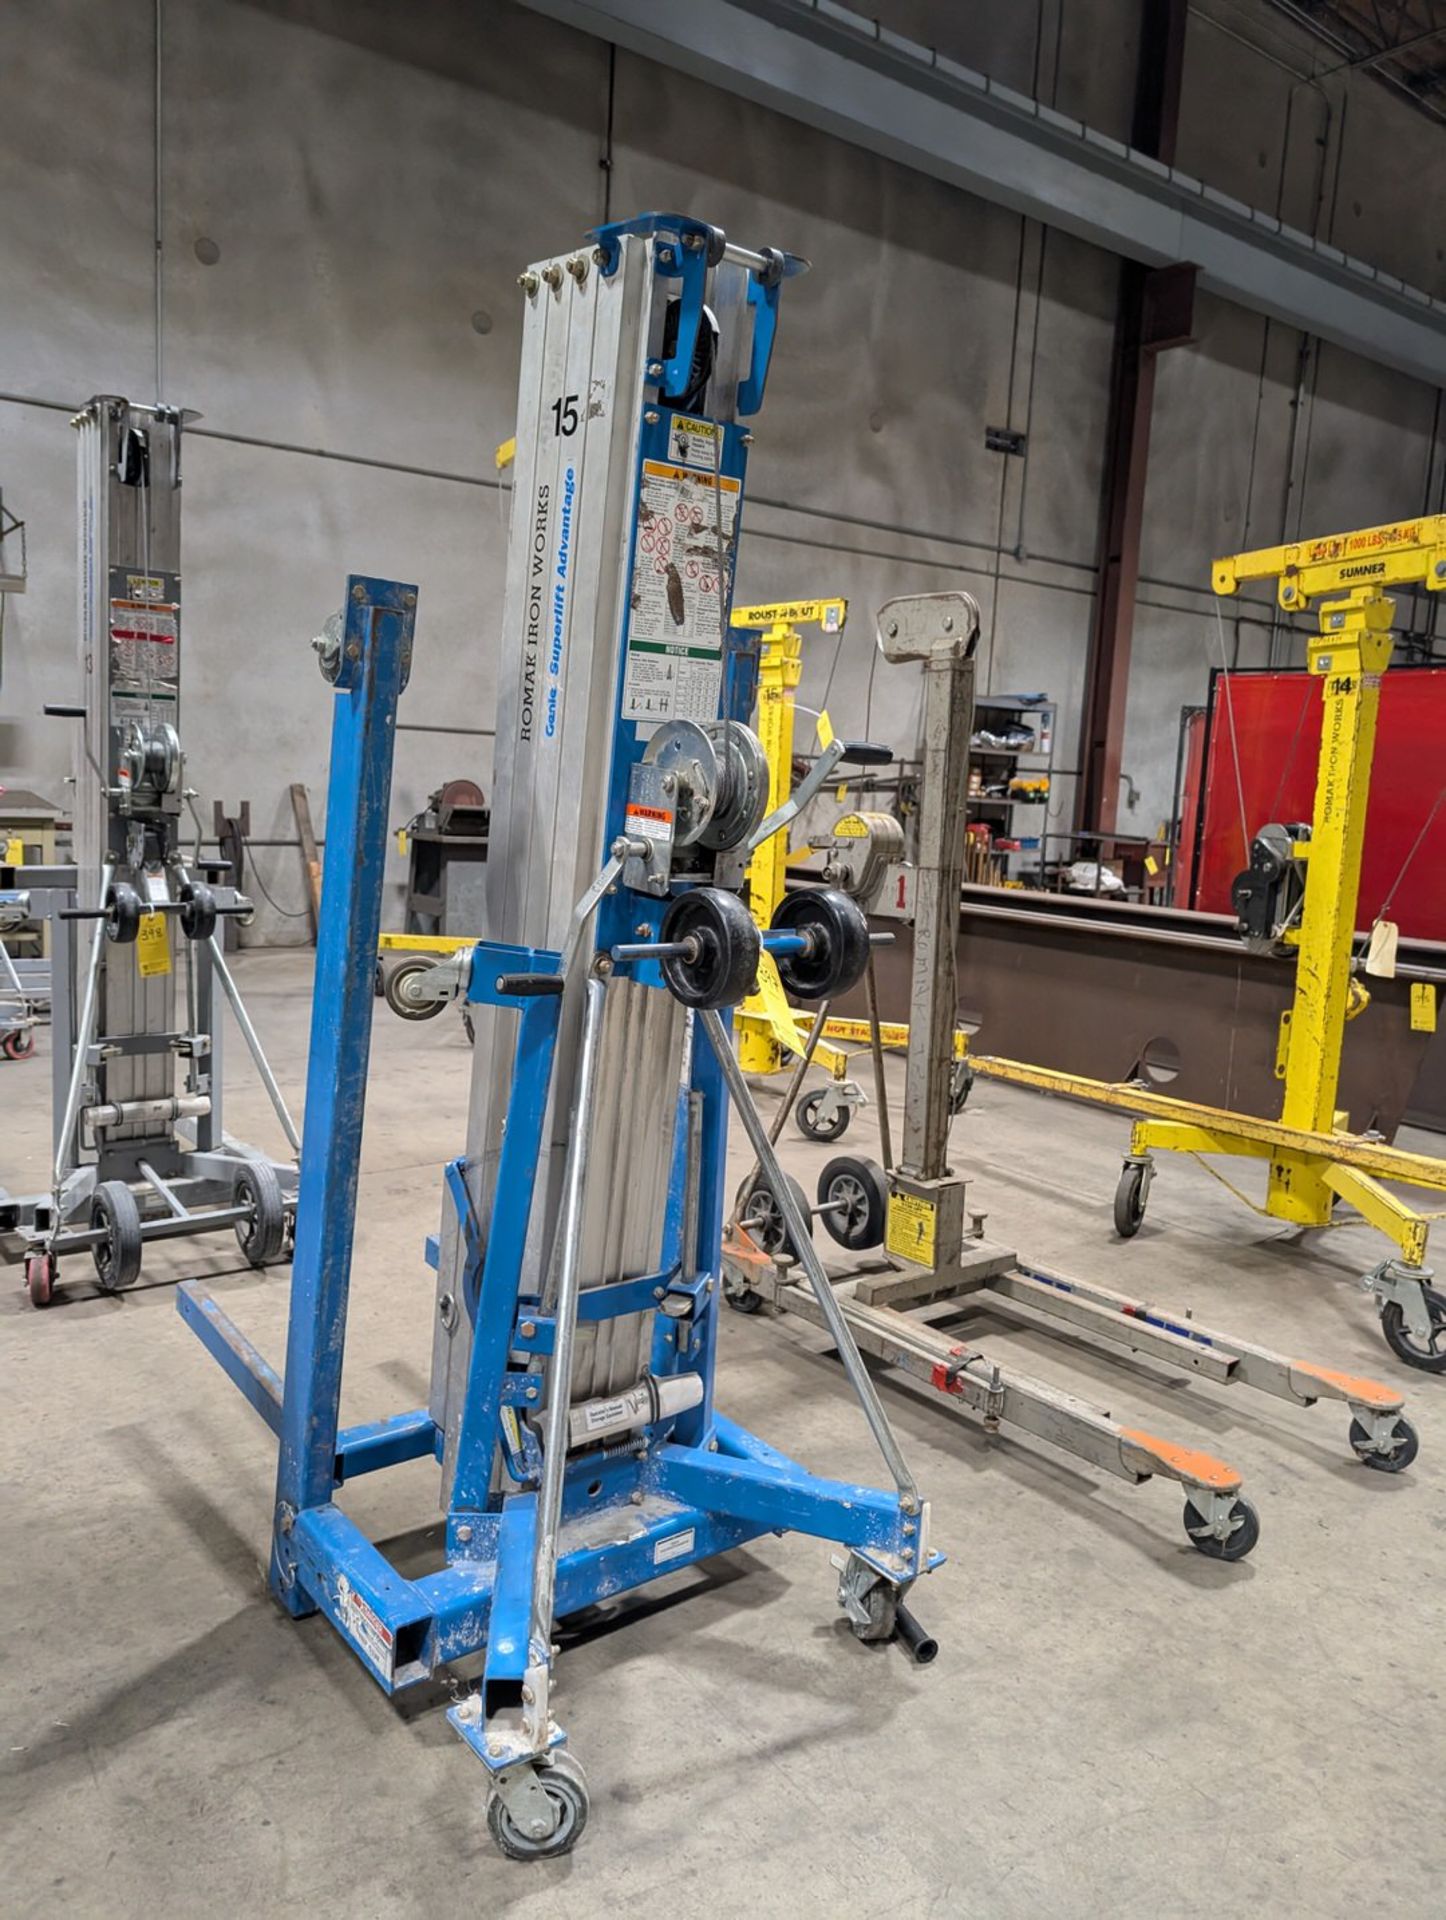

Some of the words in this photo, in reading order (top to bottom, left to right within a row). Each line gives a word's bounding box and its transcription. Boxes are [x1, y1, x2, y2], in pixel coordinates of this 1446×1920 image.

[551, 394, 579, 437] 15
[533, 484, 550, 577] WORKS
[557, 467, 576, 578] Advantage
[1339, 562, 1386, 579] SUMNER
[528, 585, 542, 646] IRON
[550, 584, 565, 676] Superlift
[521, 654, 537, 742] ROMAK
[1331, 676, 1351, 696] 14
[545, 687, 558, 738] Genie
[1332, 698, 1344, 745] WORKS
[895, 875, 906, 910] 1
